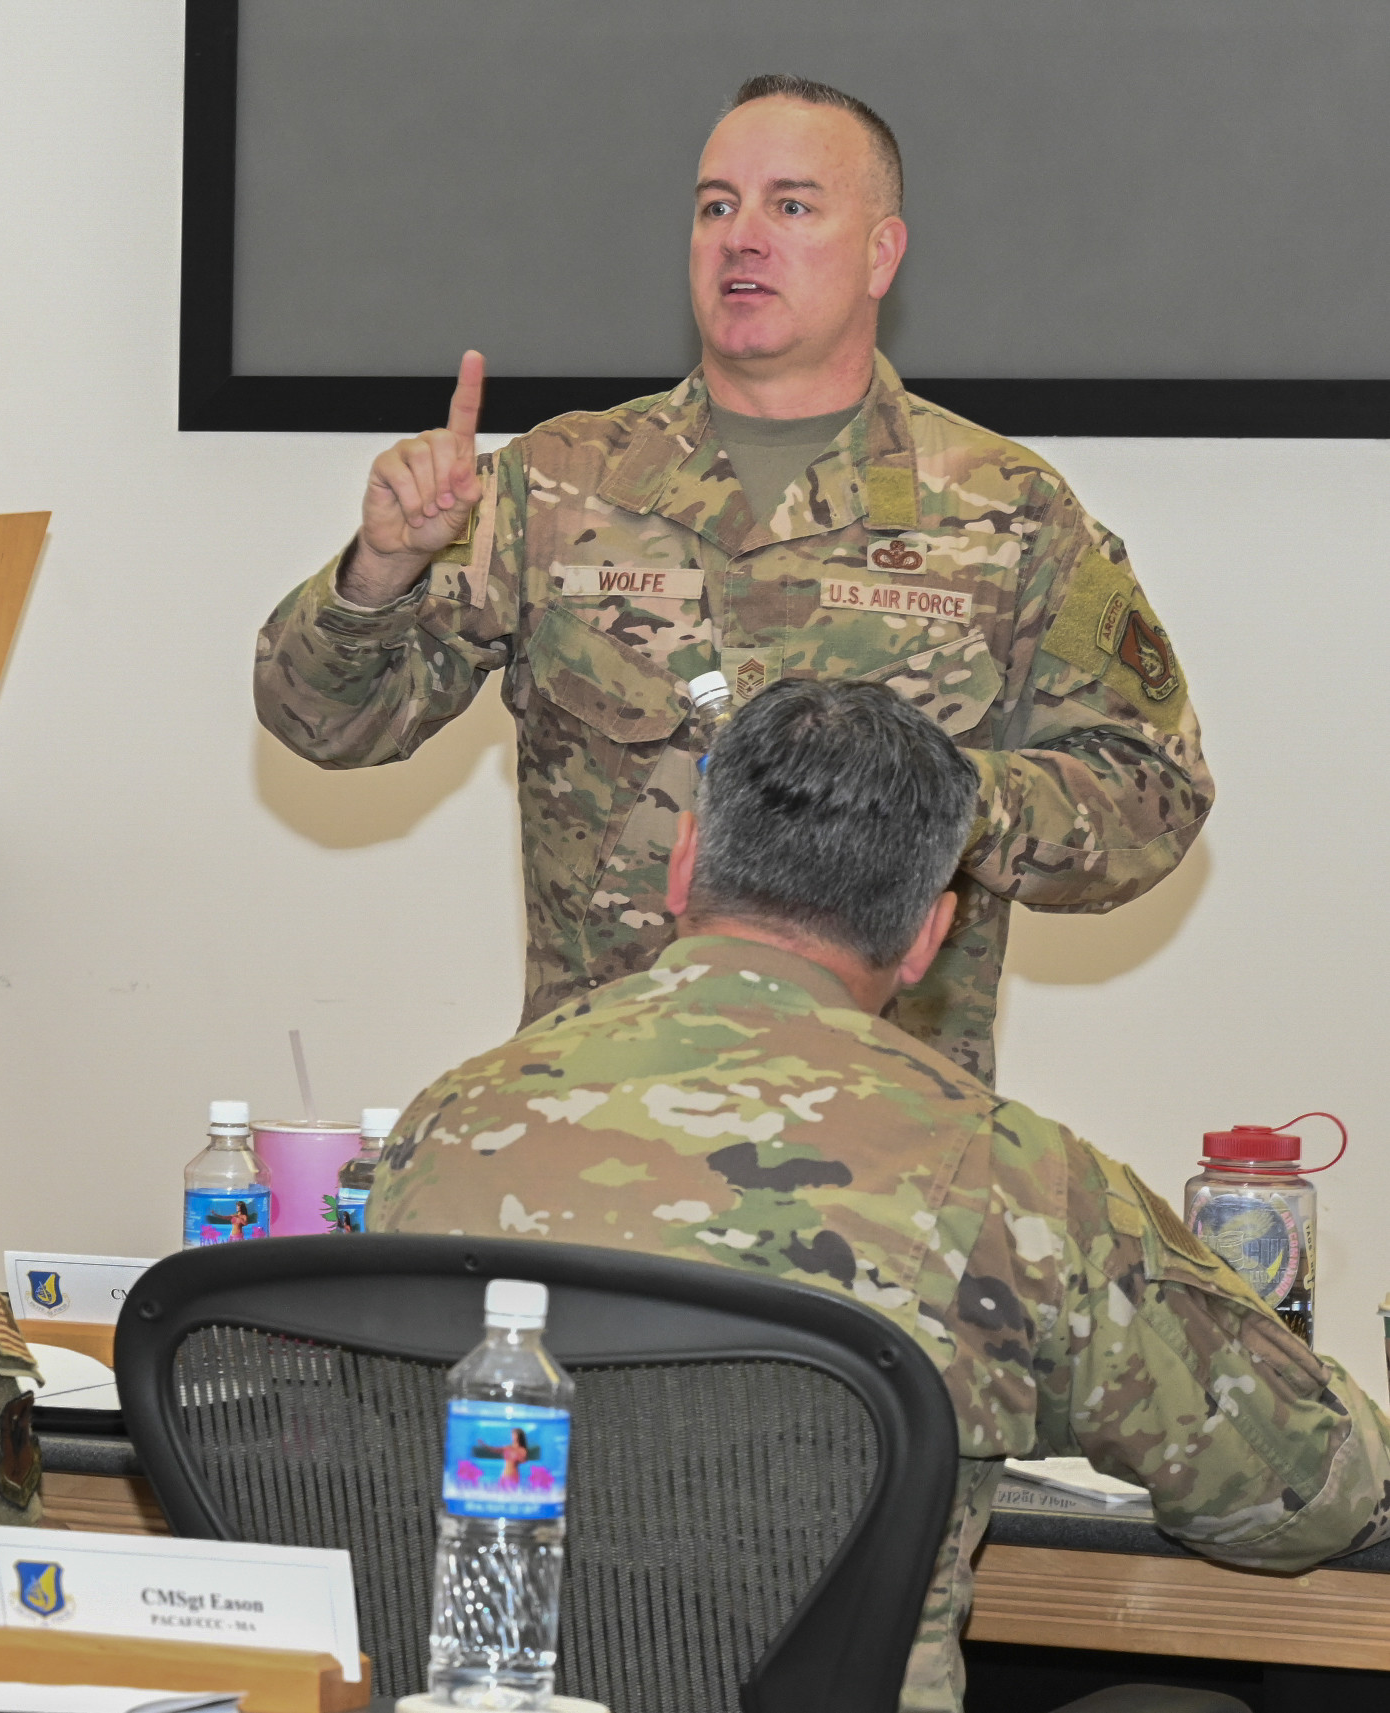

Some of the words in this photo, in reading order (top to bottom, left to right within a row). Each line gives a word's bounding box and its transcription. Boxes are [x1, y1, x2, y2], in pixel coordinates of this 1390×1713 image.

[598, 572, 665, 593] WOLFE
[829, 585, 864, 606] U.S.
[870, 589, 901, 609] AIR
[907, 593, 966, 618] FORCE
[1103, 599, 1123, 641] ARCTIC
[1282, 1212, 1294, 1229] AIR
[141, 1588, 204, 1612] CMSgt
[210, 1592, 264, 1613] Eason
